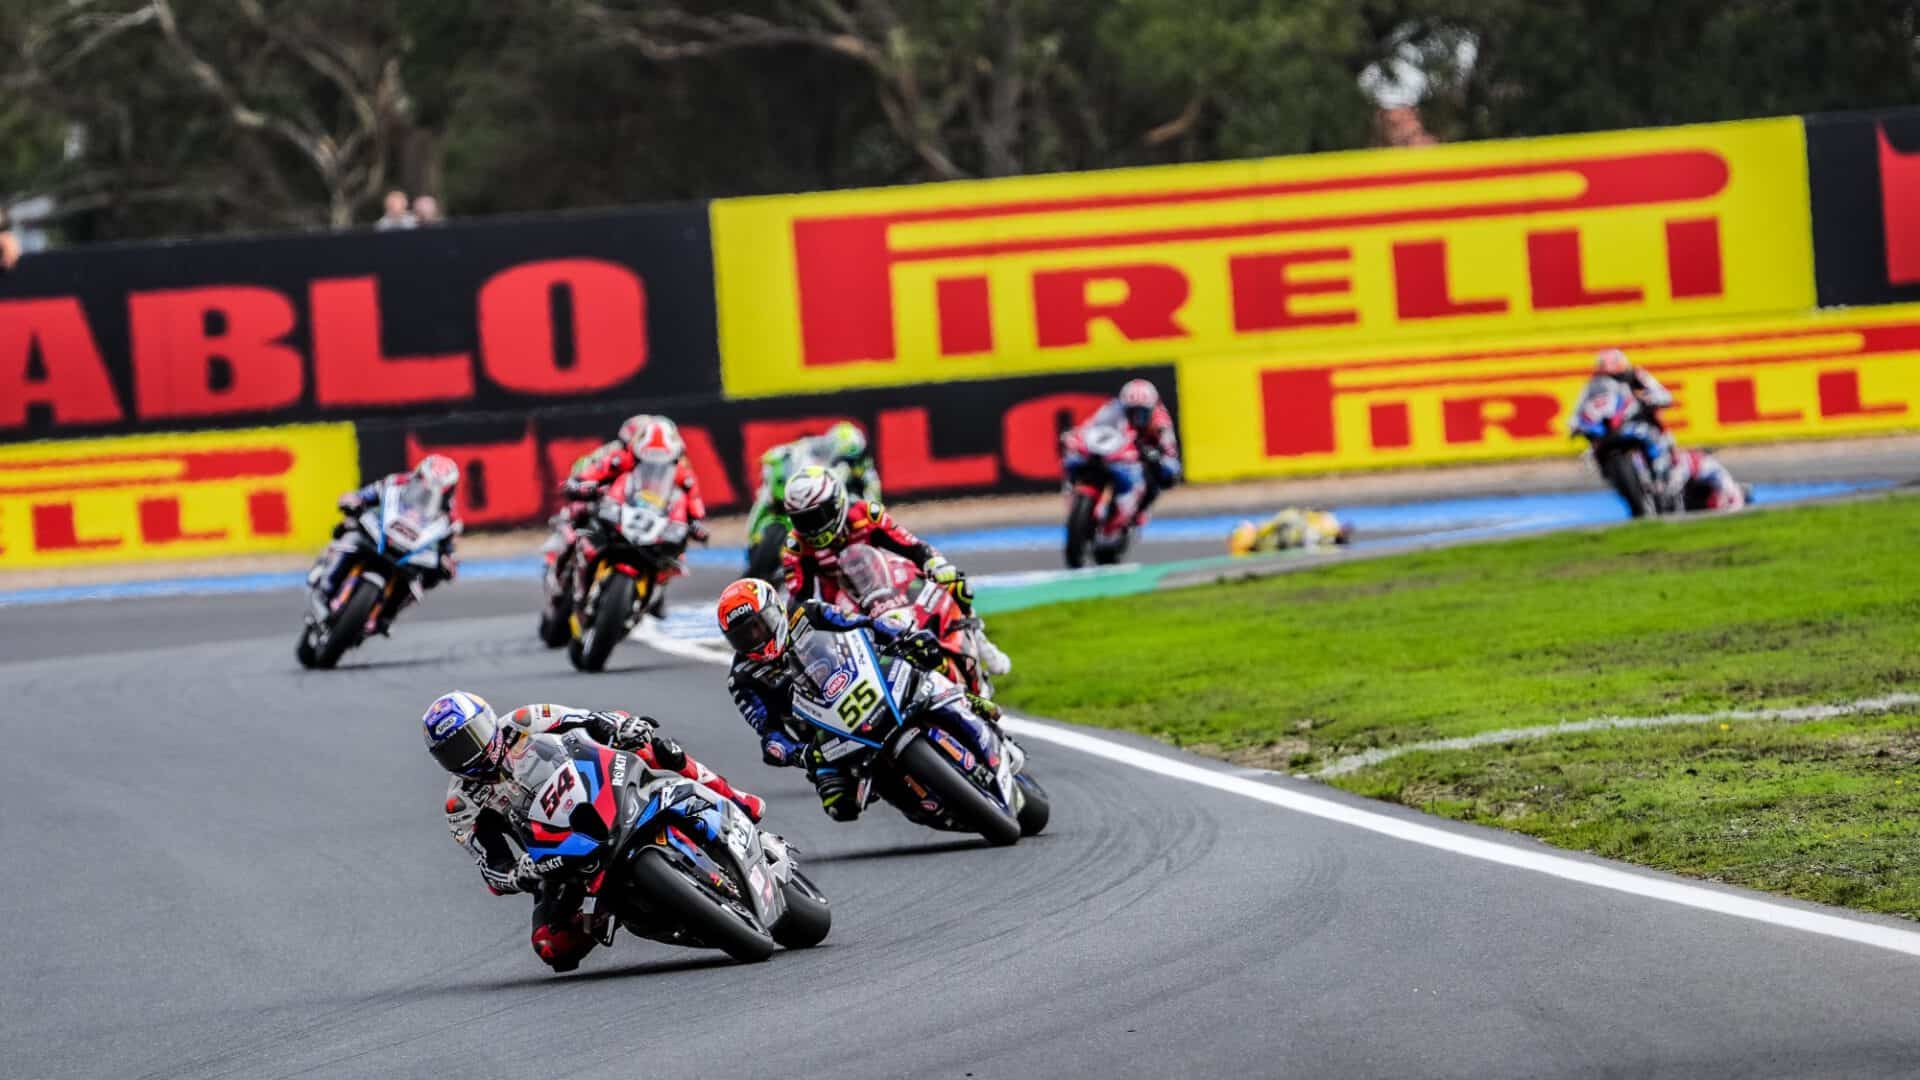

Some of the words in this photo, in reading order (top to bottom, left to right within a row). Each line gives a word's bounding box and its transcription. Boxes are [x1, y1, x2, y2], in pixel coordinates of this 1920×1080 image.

[792, 147, 1730, 368] PIRELLI
[837, 680, 878, 728] 55
[540, 766, 575, 820] 54
